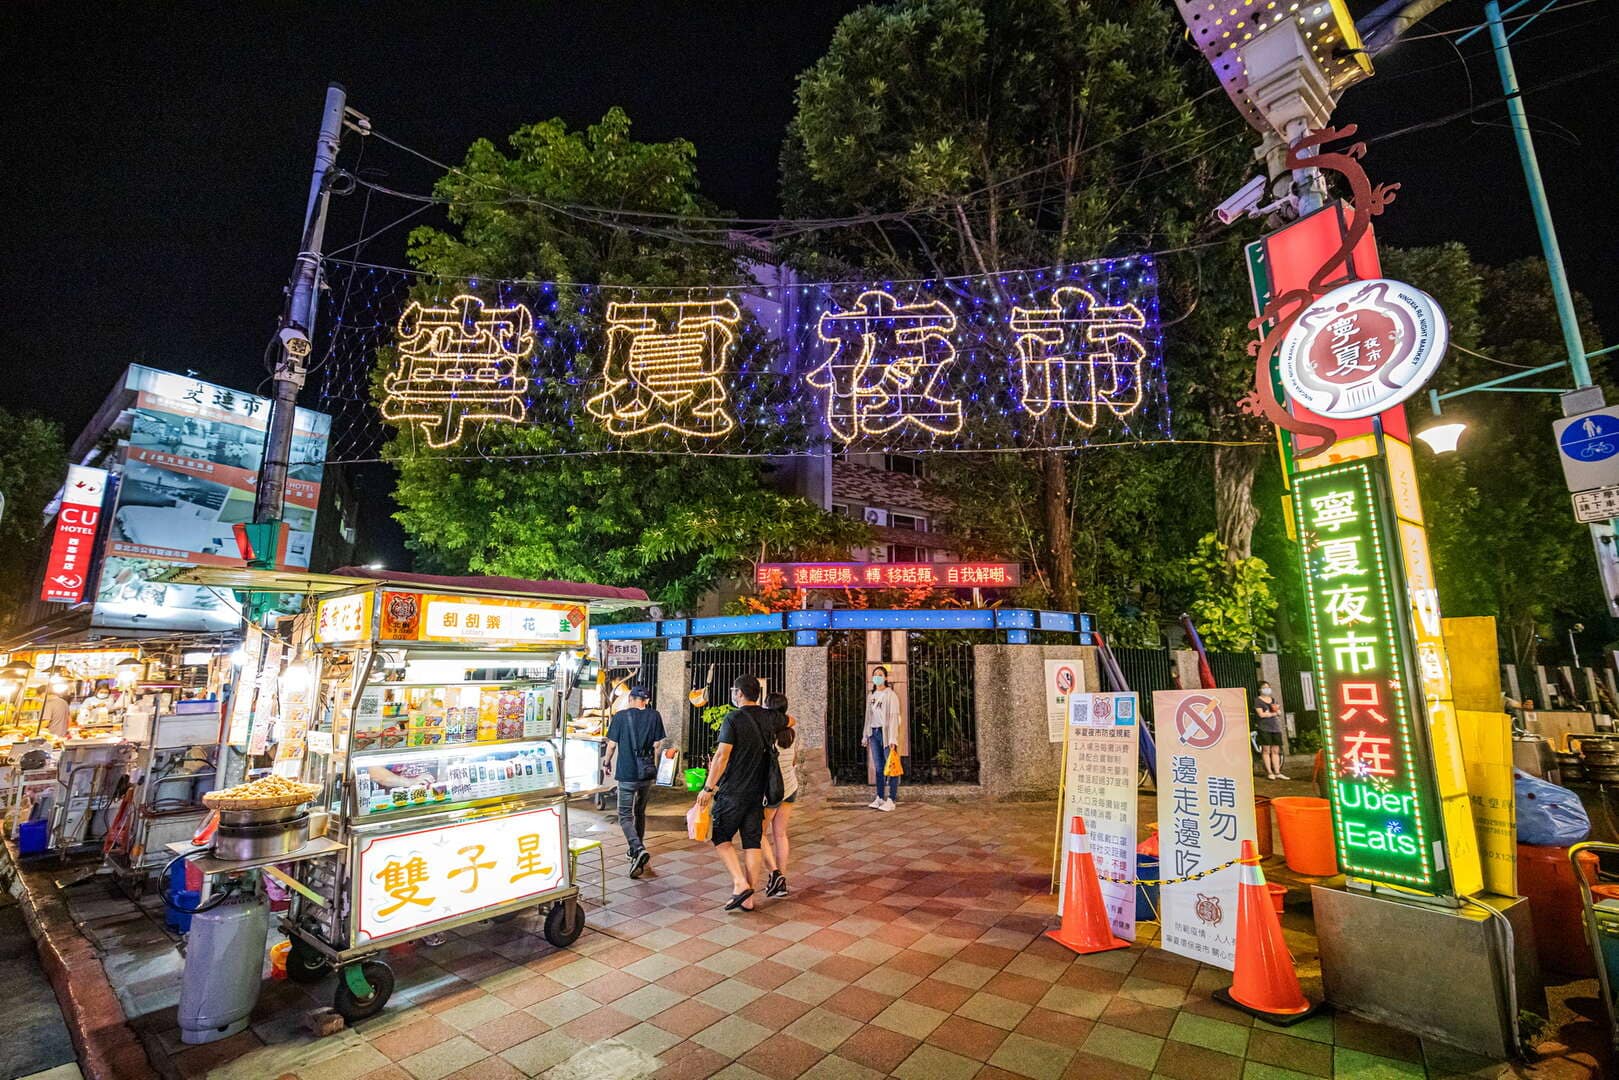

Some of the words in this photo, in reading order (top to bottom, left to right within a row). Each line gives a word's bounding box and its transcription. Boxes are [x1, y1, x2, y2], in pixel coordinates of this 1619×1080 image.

[1326, 314, 1377, 377] 寧夏
[1363, 336, 1383, 362] 夜市
[381, 287, 1147, 447] 寧夏夜市
[60, 525, 95, 535] HOTEL
[61, 508, 99, 525] CU
[443, 612, 501, 630] 刮刮樂
[1207, 776, 1238, 842] 請勿
[1339, 783, 1414, 815] Uber
[1172, 755, 1201, 880] 邊走邊吃
[1344, 821, 1417, 857] Eats
[375, 833, 553, 917] 雙子星
